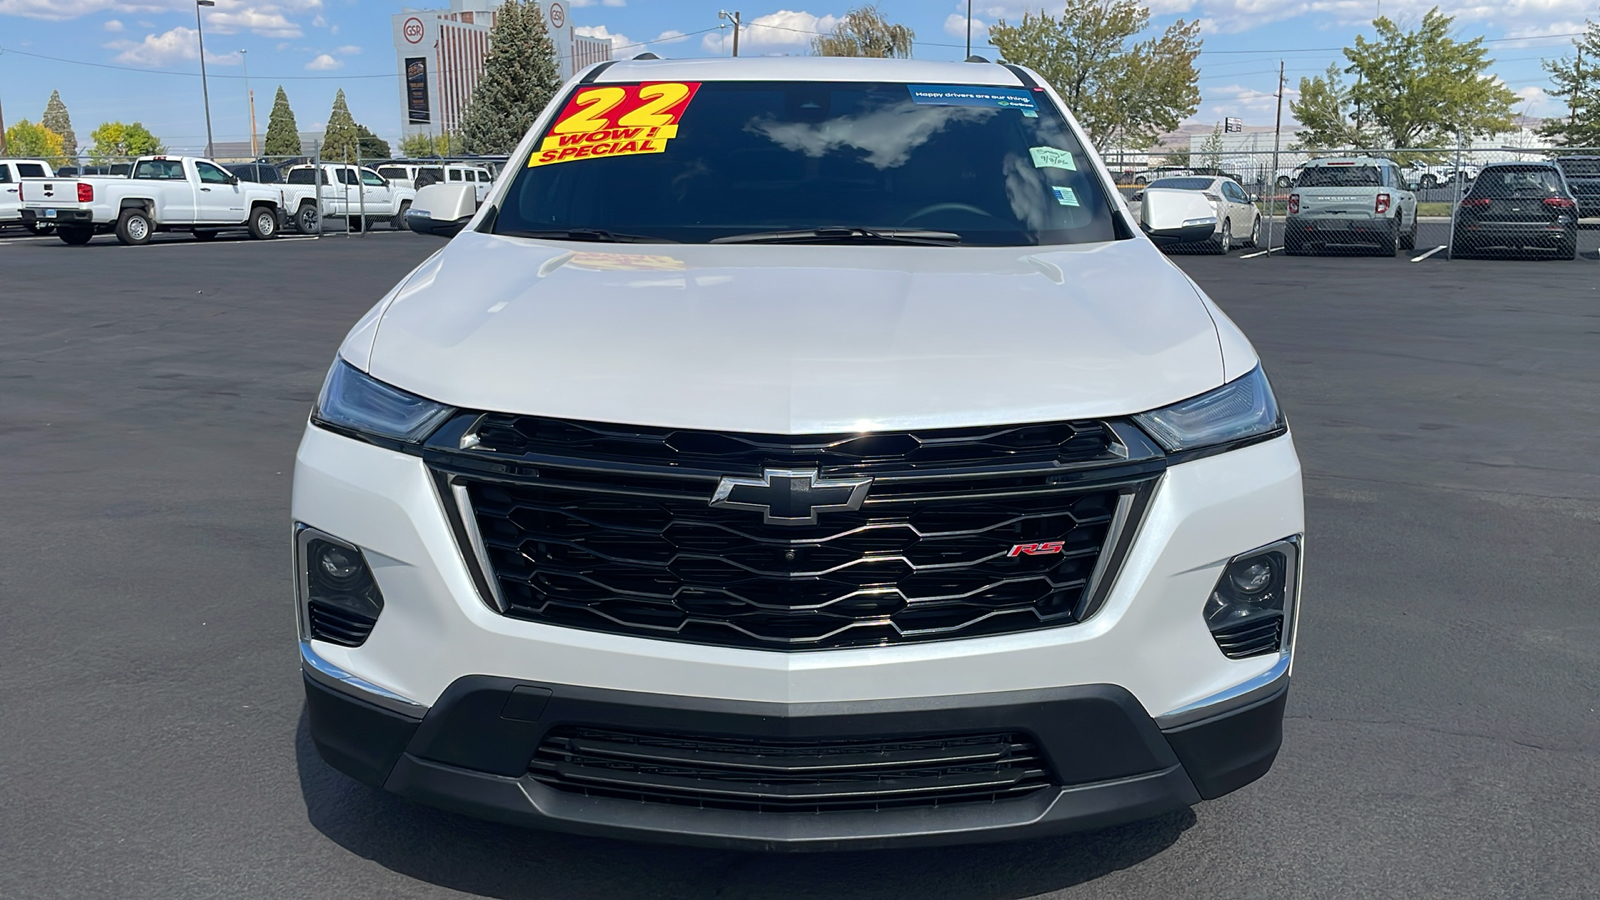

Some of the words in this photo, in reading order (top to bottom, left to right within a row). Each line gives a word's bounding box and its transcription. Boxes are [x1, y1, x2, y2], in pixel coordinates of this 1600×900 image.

[406, 24, 422, 37] GSR
[553, 83, 691, 134] 22
[538, 139, 657, 163] SPECIAL
[1006, 540, 1066, 557] RS
